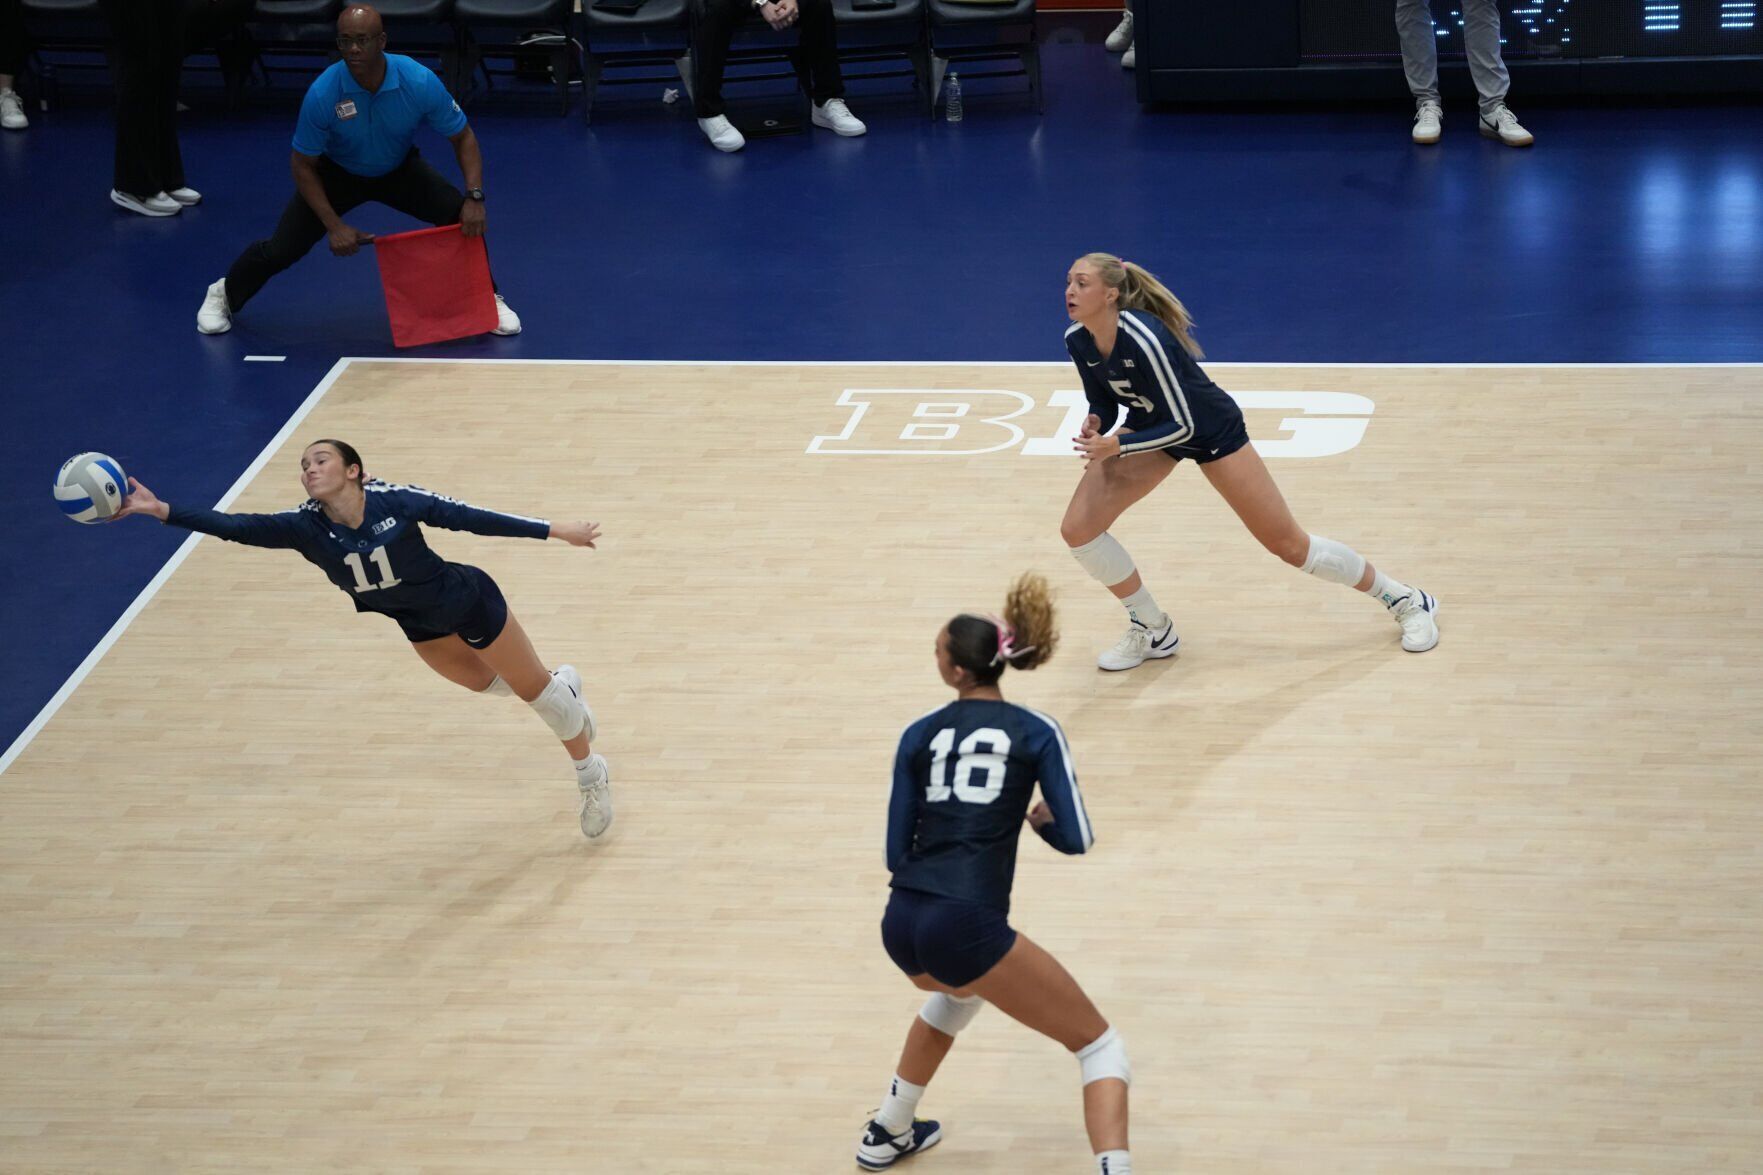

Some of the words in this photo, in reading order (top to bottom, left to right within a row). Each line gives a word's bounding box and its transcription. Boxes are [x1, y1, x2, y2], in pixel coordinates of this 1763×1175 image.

[1108, 379, 1154, 413] 5
[343, 545, 402, 593] 11
[925, 727, 1012, 805] 18
